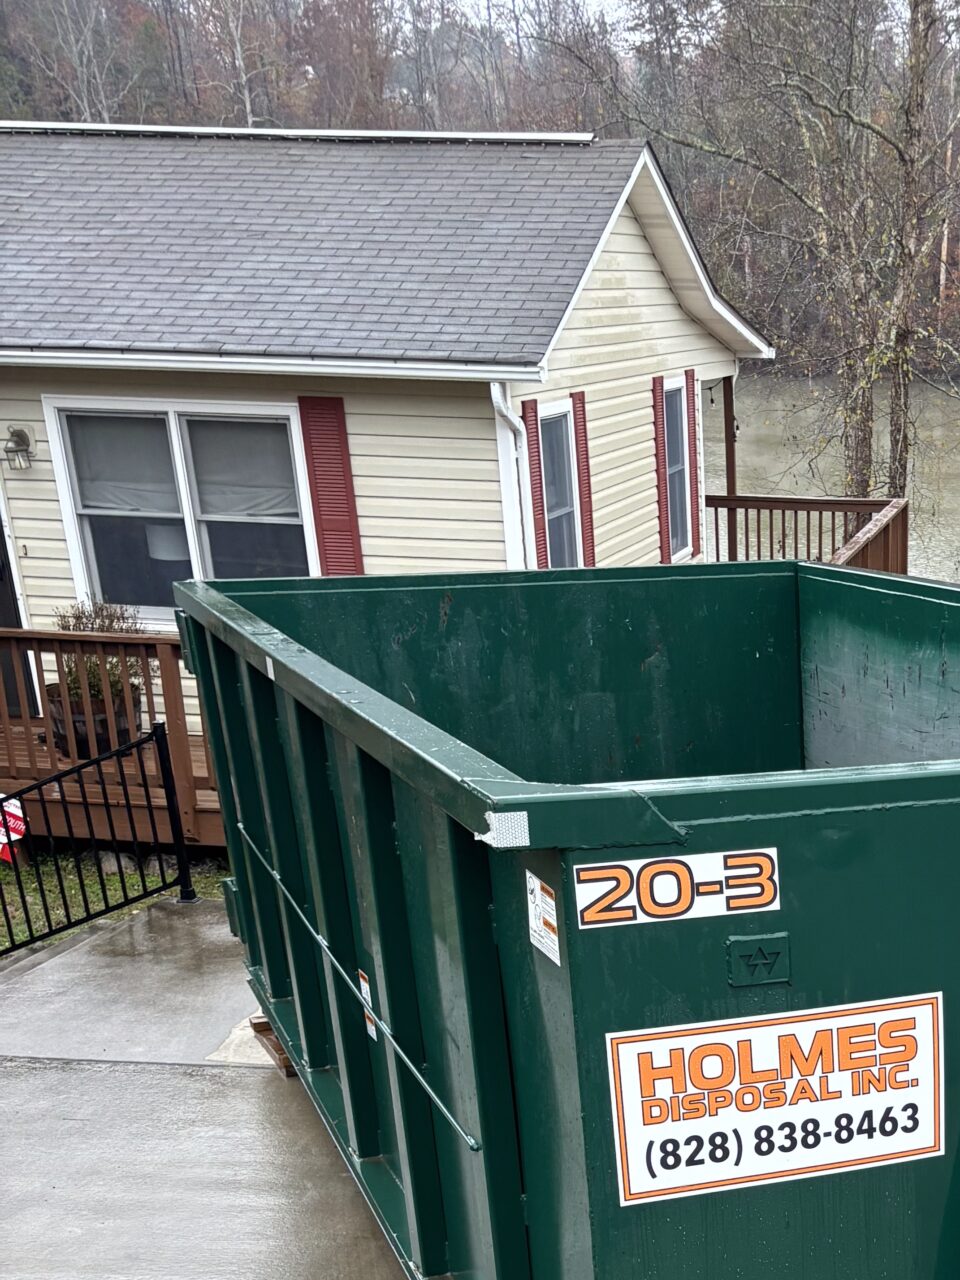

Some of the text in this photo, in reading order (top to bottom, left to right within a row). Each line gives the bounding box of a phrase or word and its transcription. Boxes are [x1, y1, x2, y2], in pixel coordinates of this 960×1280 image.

[575, 851, 778, 926] 20-3
[637, 1017, 918, 1098] HOLMES
[641, 1063, 919, 1126] DISPOSAL INC.
[645, 1102, 920, 1179] (828) 838-8463
